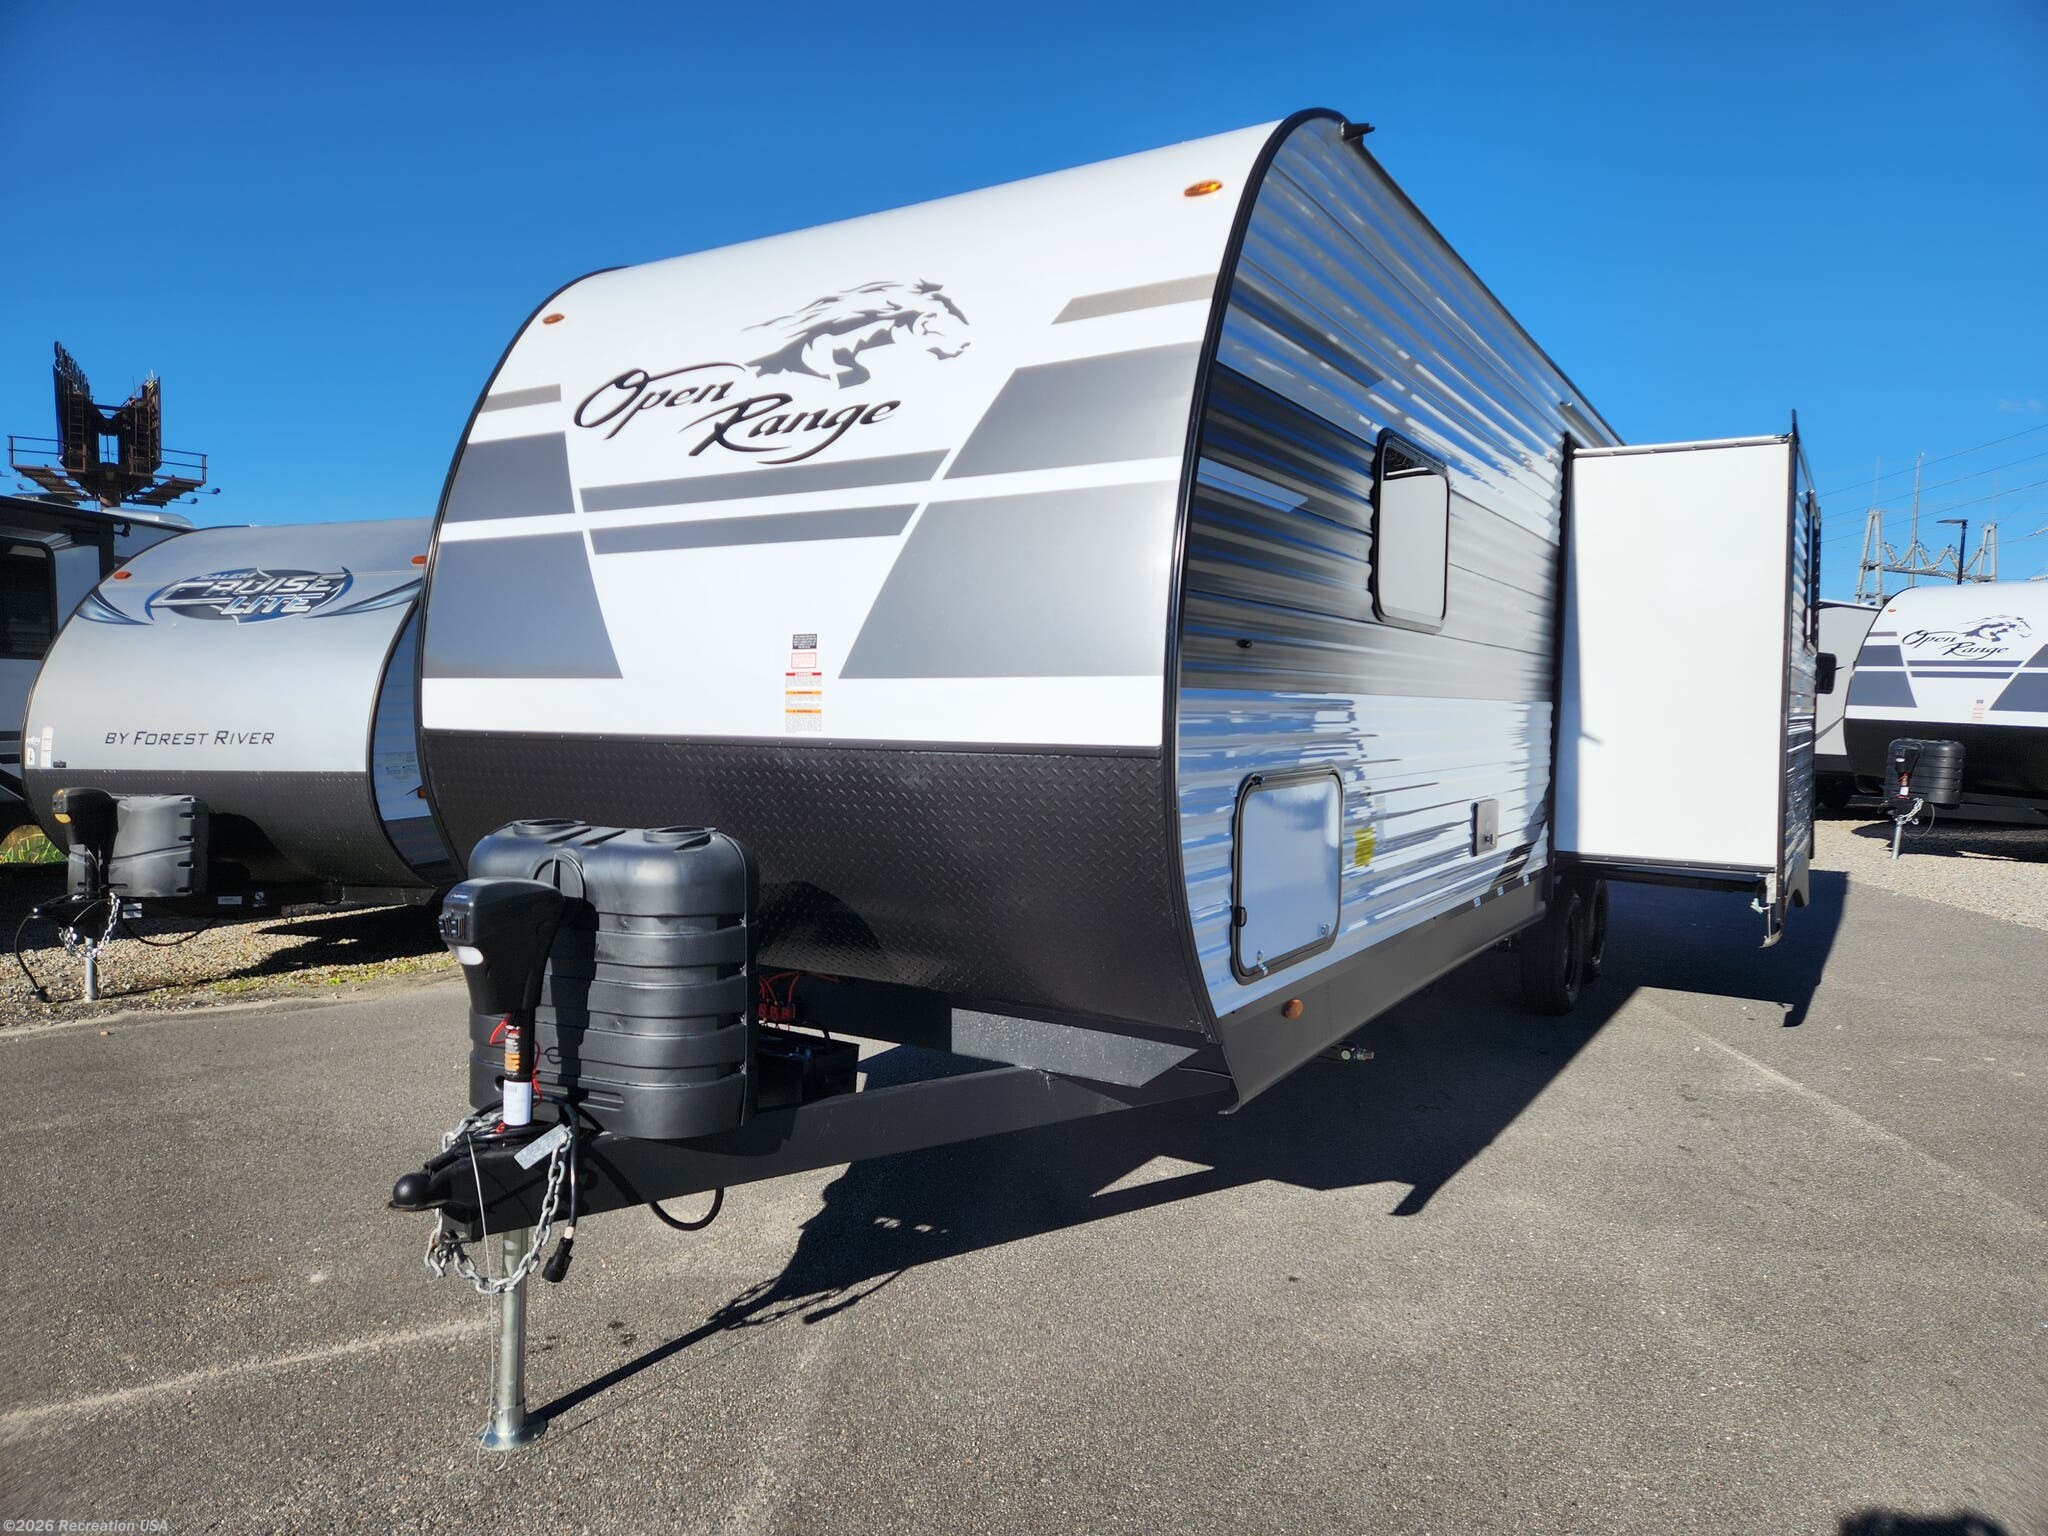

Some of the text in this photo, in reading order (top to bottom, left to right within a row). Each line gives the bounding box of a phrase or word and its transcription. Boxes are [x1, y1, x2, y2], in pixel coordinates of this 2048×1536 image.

[573, 362, 746, 440] Open
[678, 393, 901, 465] Range
[150, 573, 347, 607] CRUISE
[220, 592, 325, 616] LITE
[1902, 629, 1961, 649] Open
[1939, 641, 2009, 660] Range
[105, 730, 275, 746] BY FOREST RIVER
